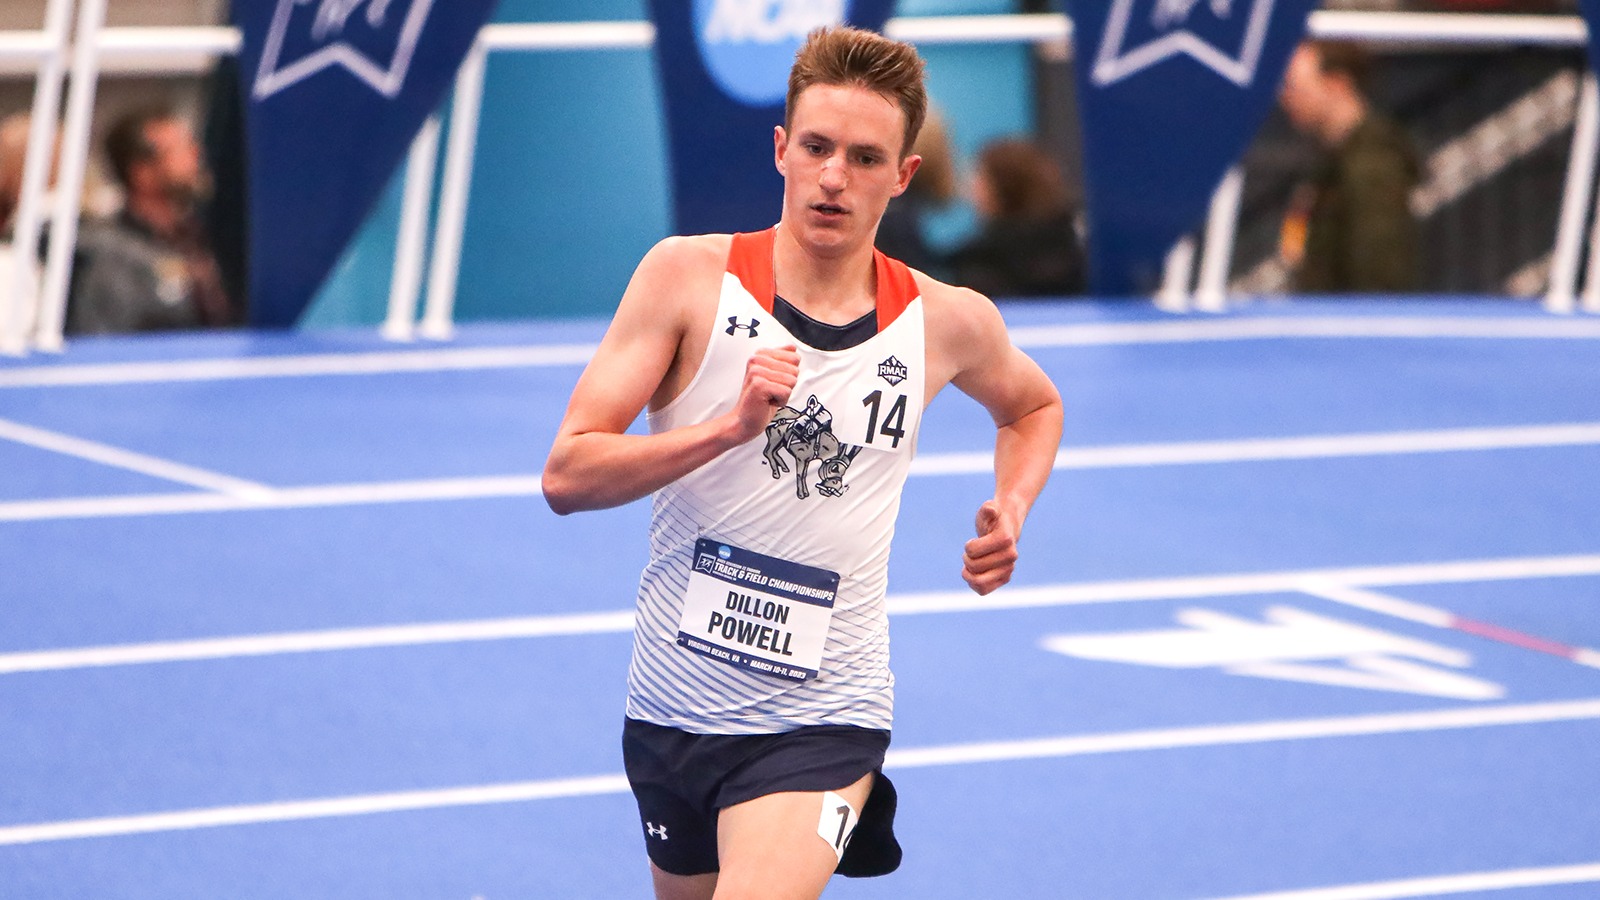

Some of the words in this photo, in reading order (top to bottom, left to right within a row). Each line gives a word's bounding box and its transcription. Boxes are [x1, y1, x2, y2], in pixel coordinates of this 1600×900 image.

[879, 365, 907, 378] RMAC
[862, 390, 907, 448] 14
[714, 562, 739, 577] TRACK
[738, 569, 746, 579] &
[744, 572, 768, 585] FIELD
[768, 578, 834, 601] CHAMPIONSHIPS
[725, 590, 790, 625] DILLON
[707, 610, 793, 656] POWELL
[687, 639, 711, 653] VIRGINIA
[710, 647, 731, 661] BEACH,
[731, 654, 740, 663] VA
[750, 660, 773, 672] MARCH
[788, 669, 806, 679] 2023
